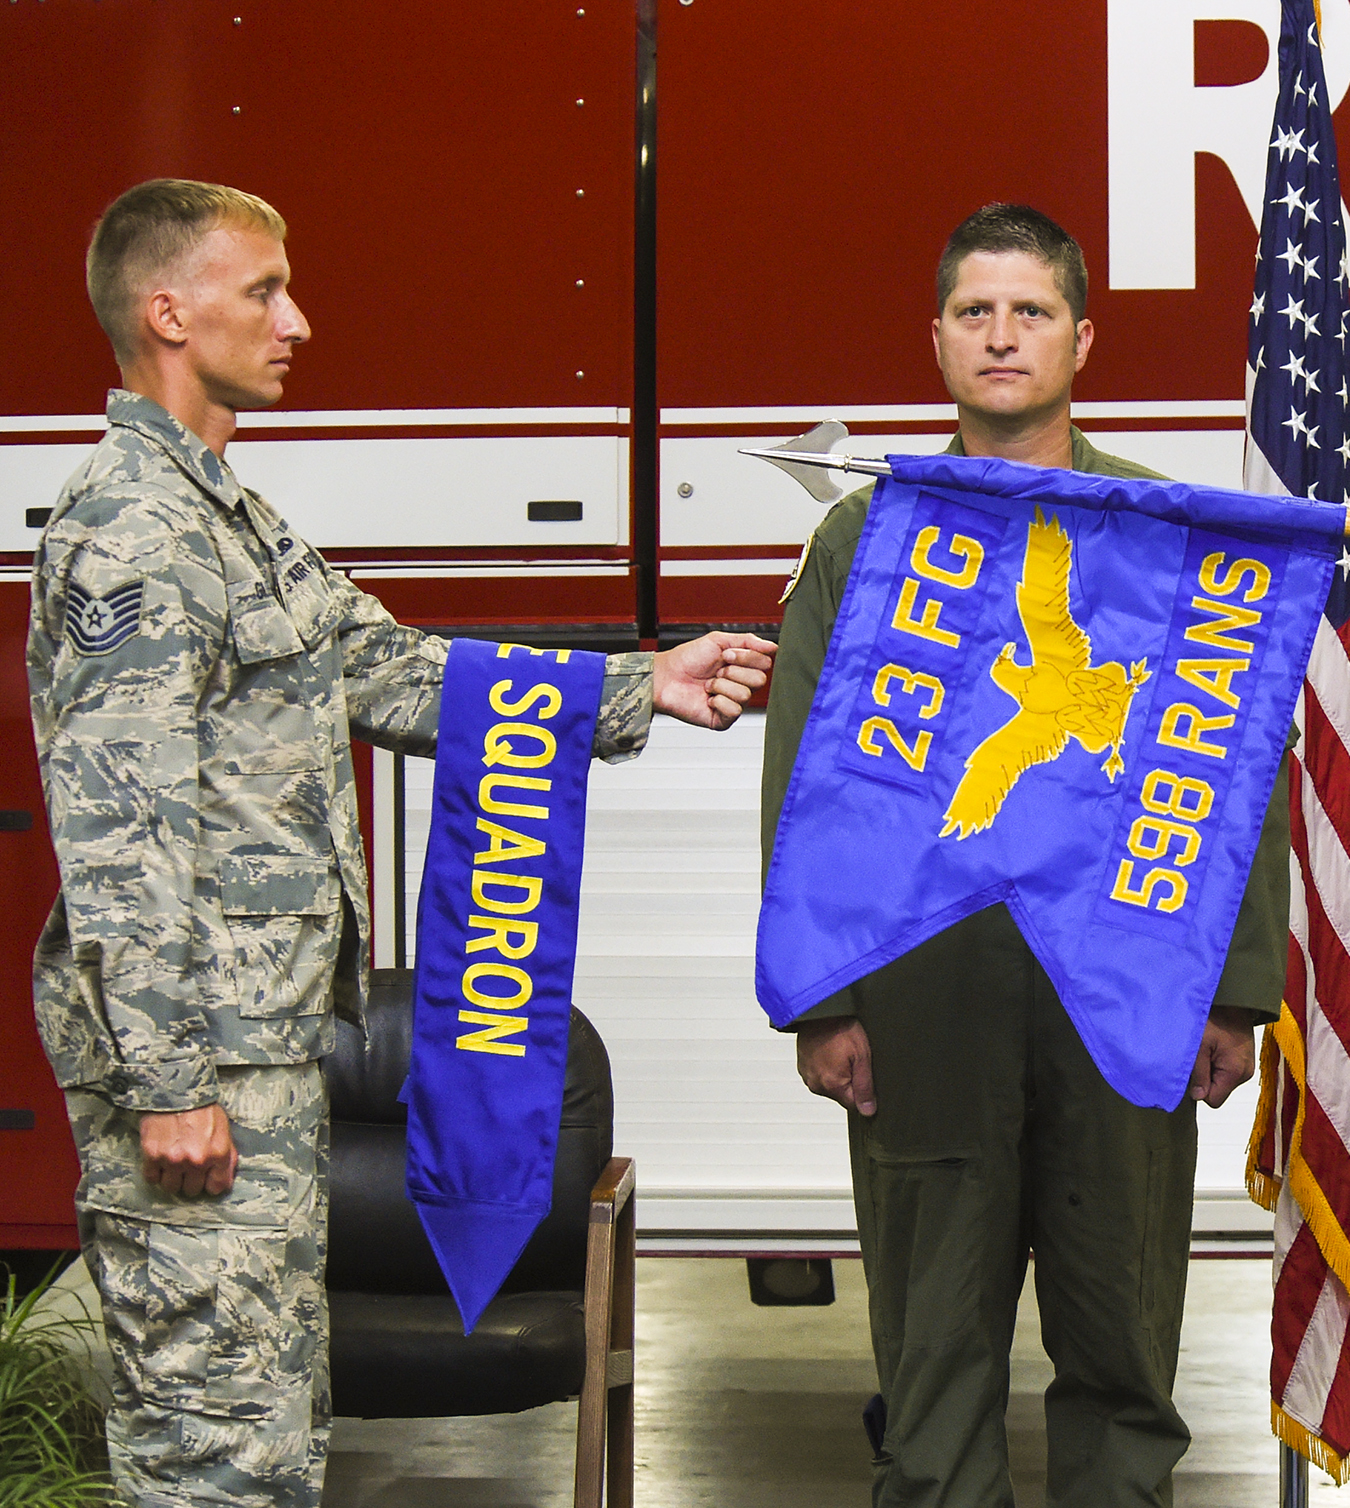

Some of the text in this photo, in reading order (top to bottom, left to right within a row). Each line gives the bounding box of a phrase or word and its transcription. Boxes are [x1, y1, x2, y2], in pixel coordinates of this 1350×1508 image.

[287, 562, 310, 585] AIR
[857, 525, 985, 773] 23 FG
[456, 679, 562, 1057] SQUADRON
[1109, 552, 1272, 914] 598 RANS
